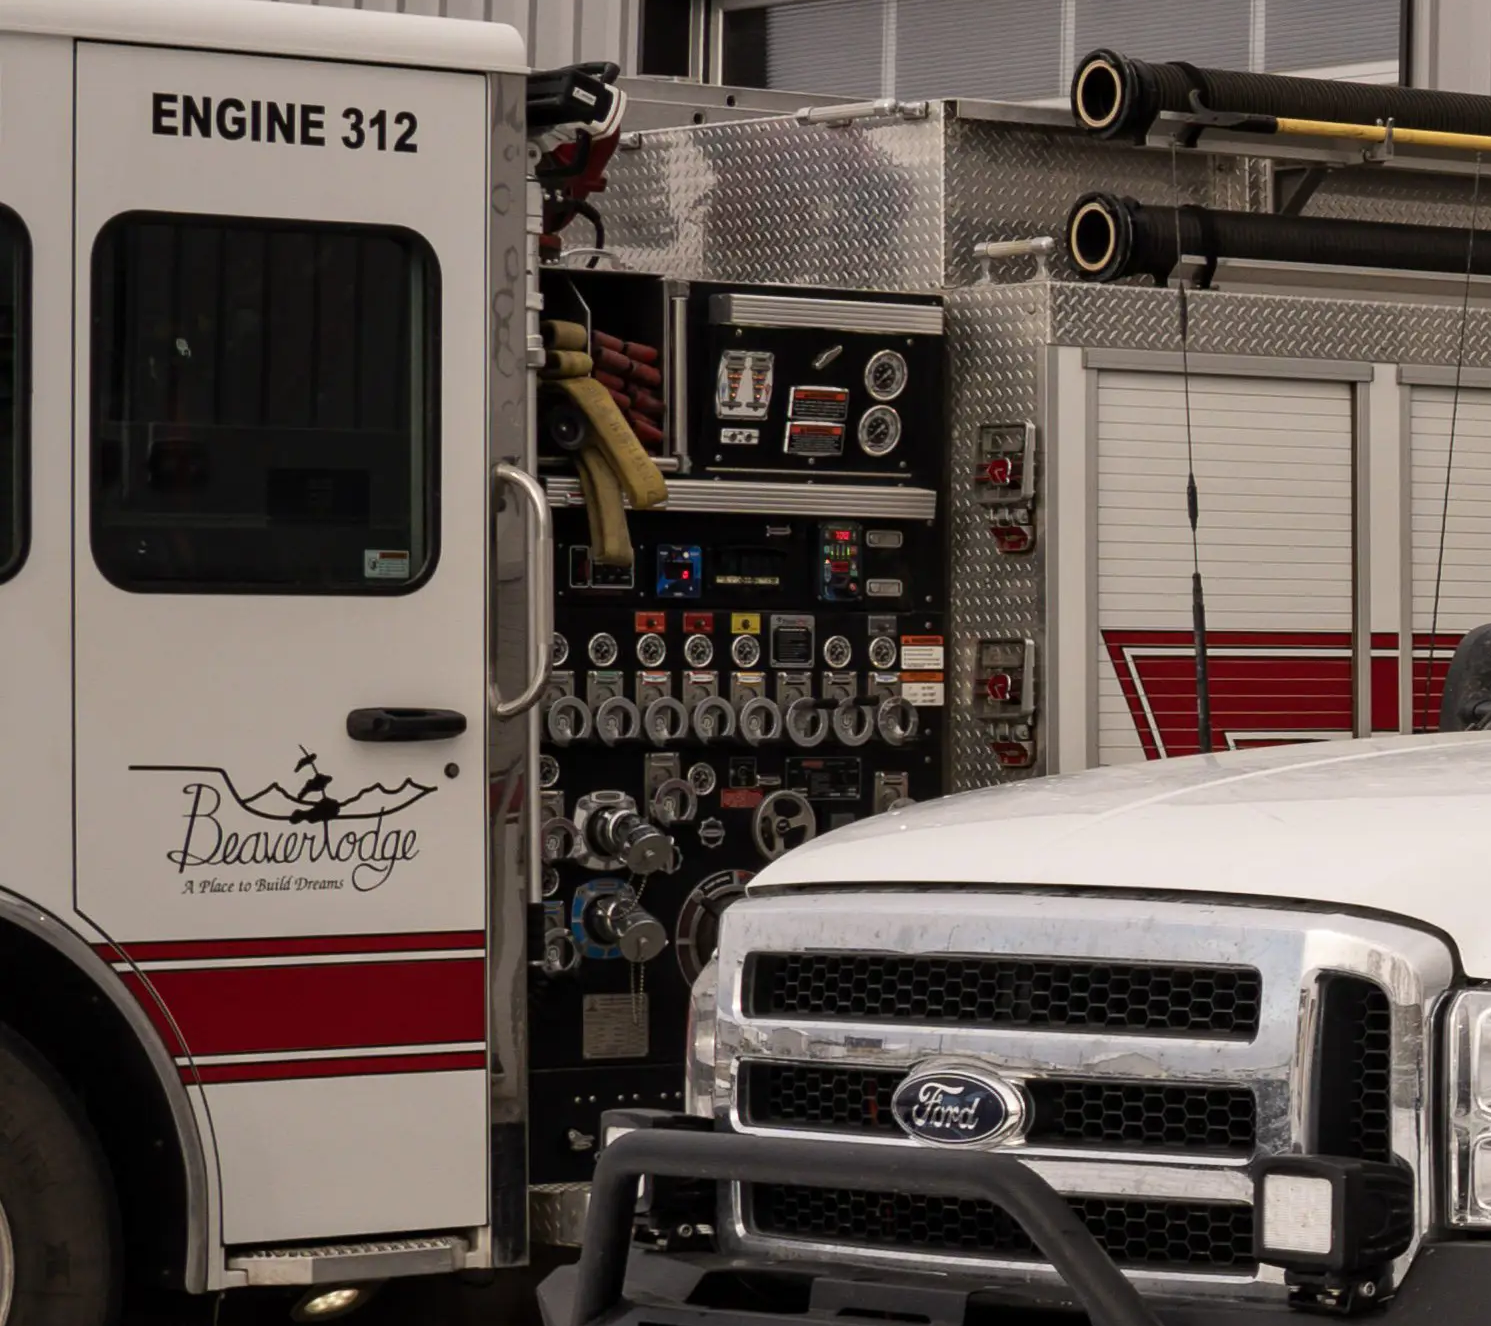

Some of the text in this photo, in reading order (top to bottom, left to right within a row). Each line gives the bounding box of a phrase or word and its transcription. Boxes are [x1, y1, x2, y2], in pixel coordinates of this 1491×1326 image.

[152, 92, 418, 153] ENGINE 312
[166, 782, 420, 893] Beaverlodge
[181, 875, 345, 894] A Place to Build Dreams
[911, 1081, 981, 1131] Ford
